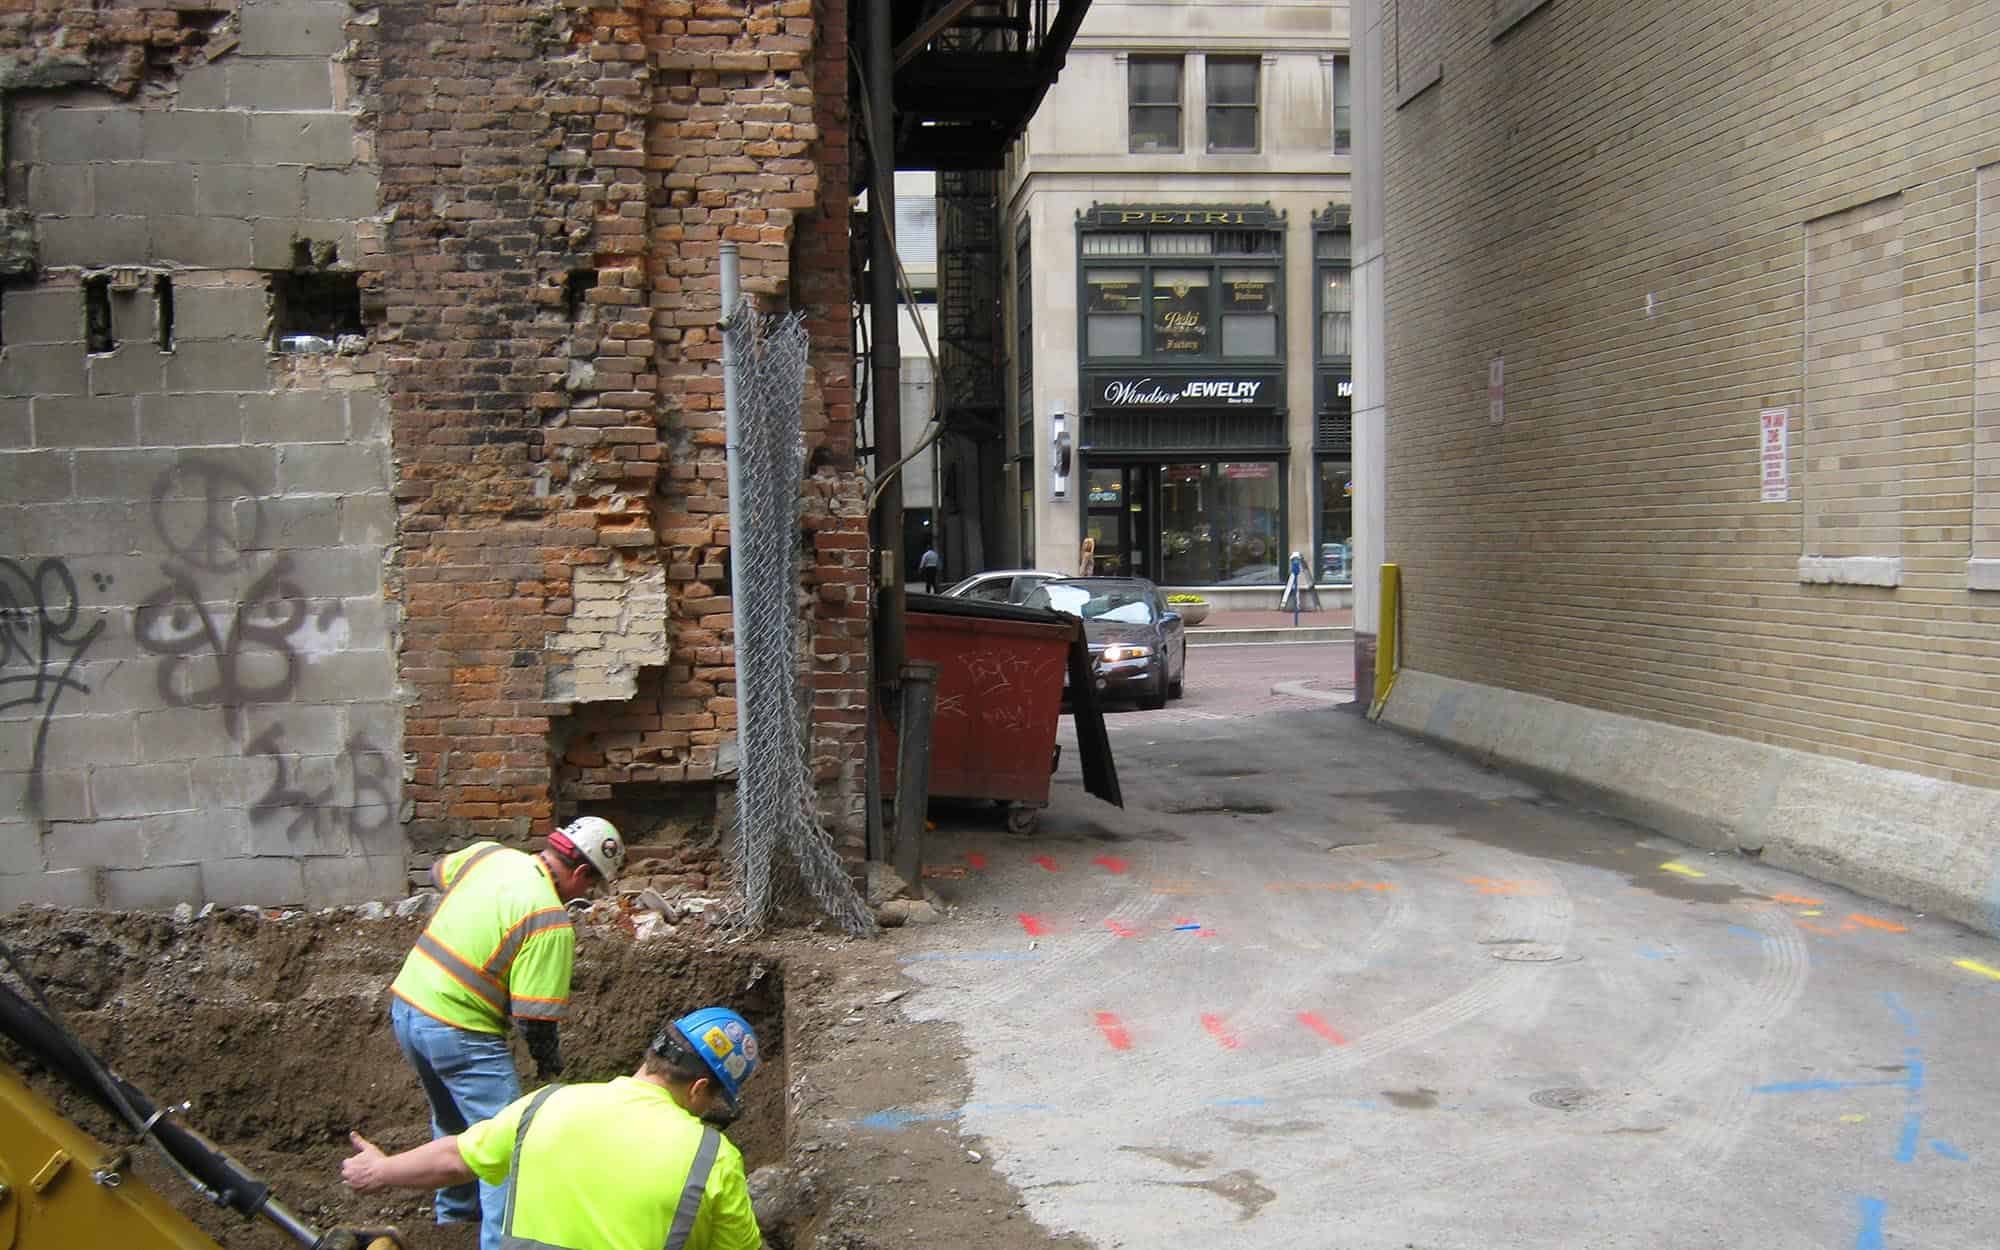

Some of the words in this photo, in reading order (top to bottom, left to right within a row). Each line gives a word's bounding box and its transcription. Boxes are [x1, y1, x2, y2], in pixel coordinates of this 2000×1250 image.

[1120, 211, 1246, 224] PETRI
[1104, 378, 1180, 406] Windsor
[1181, 382, 1261, 397] JEWELRY
